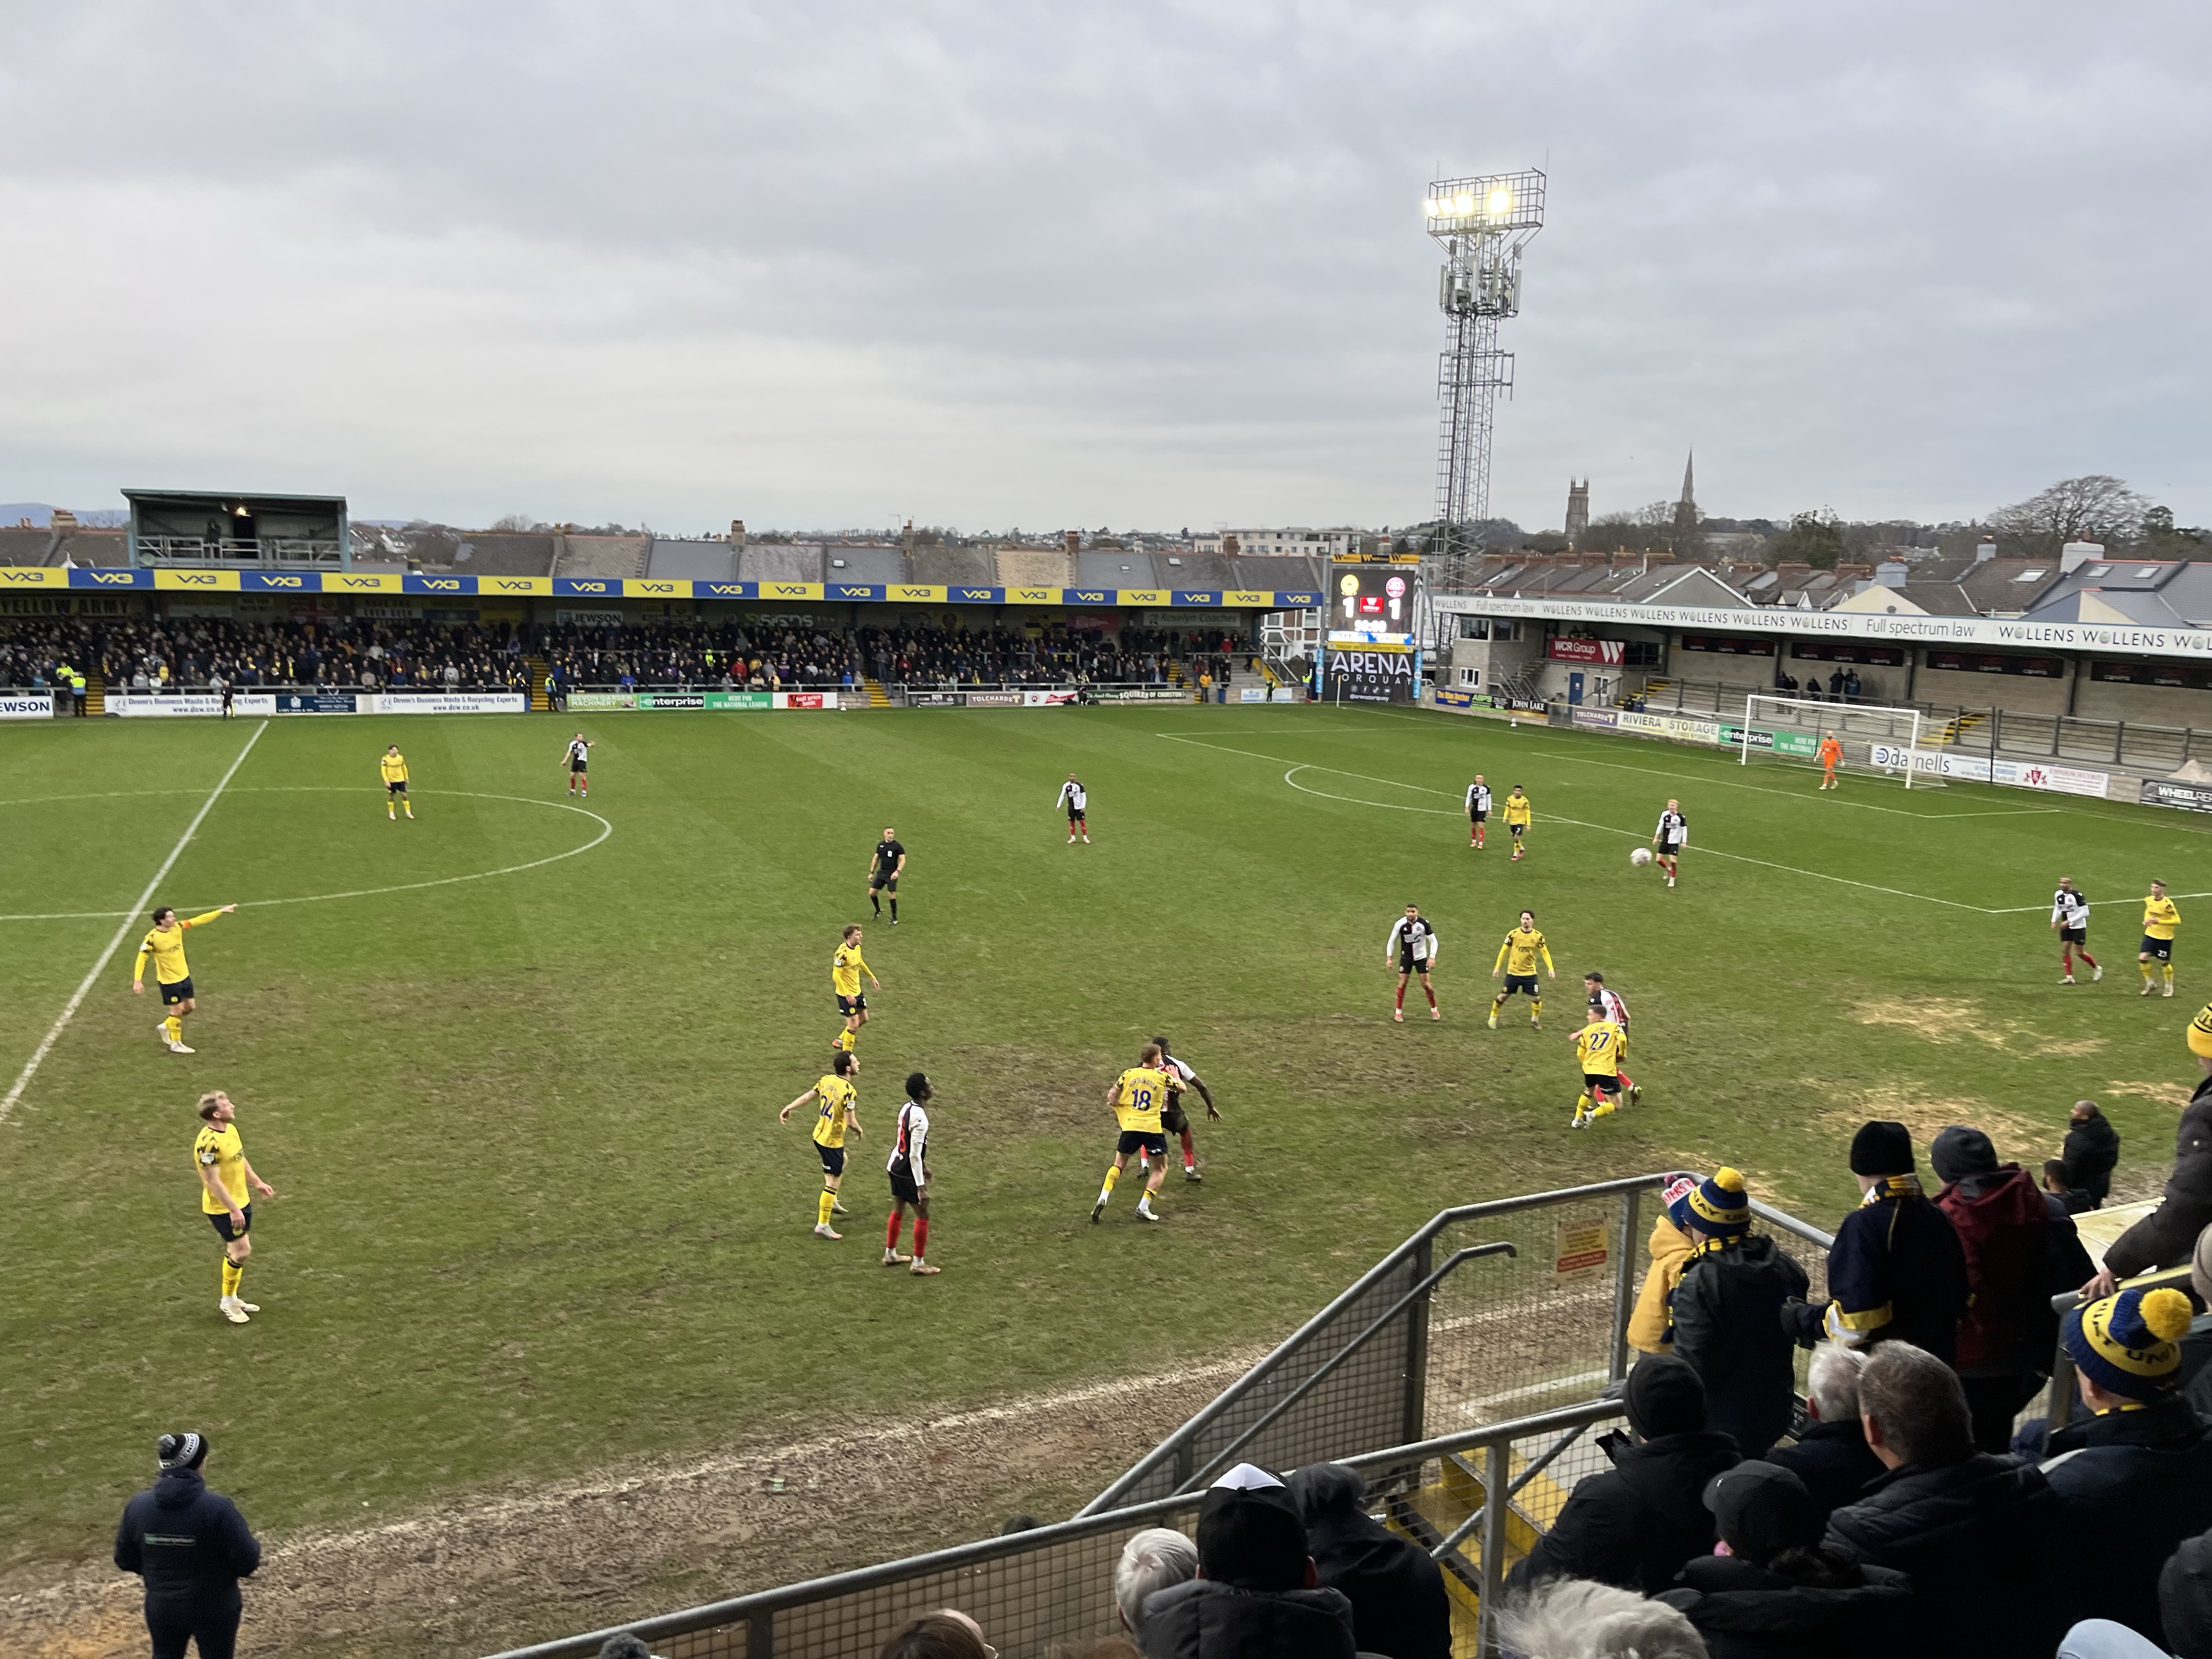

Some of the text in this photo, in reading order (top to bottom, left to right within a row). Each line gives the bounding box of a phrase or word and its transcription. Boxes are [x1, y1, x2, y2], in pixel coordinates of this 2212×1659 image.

[3, 572, 44, 582] VX3
[91, 573, 133, 584] VX3
[176, 574, 217, 584] VX3
[262, 576, 302, 586] VX3
[343, 578, 381, 588] VX3
[422, 579, 460, 590] VX3
[498, 580, 533, 590] VX3
[572, 582, 606, 592] VX3
[641, 583, 674, 592] VX3
[710, 584, 743, 594] VX3
[776, 586, 807, 595] VX3
[840, 587, 871, 596] VX3
[902, 588, 931, 597] VX3
[963, 590, 991, 599] VX3
[1020, 591, 1047, 600] VX3
[1077, 592, 1104, 601] VX3
[1131, 593, 1157, 601] VX3
[1185, 594, 1210, 602] VX3
[1237, 594, 1260, 602] VX3
[1287, 595, 1311, 603] VX3
[1342, 597, 1354, 618] 1
[1389, 598, 1401, 620] 1
[574, 613, 622, 623] JEWSON
[1488, 602, 1521, 612] spectrum
[1522, 602, 1534, 613] law
[1867, 619, 1887, 632] Full
[1889, 620, 1948, 636] spectrum
[1953, 622, 1975, 637] law
[1555, 641, 1595, 656] WCR Group
[1330, 651, 1412, 676] ARENA
[1330, 673, 1412, 685] TORQUAY
[1119, 691, 1149, 699] SQUIRES
[644, 695, 703, 707] enterprise
[1512, 699, 1530, 708] JOHN
[1530, 701, 1544, 711] LAKE
[1623, 714, 1661, 728] RIVIERA
[1669, 720, 1717, 735] STORAGE
[1590, 1032, 1610, 1051] 27
[1132, 1089, 1152, 1111] 18
